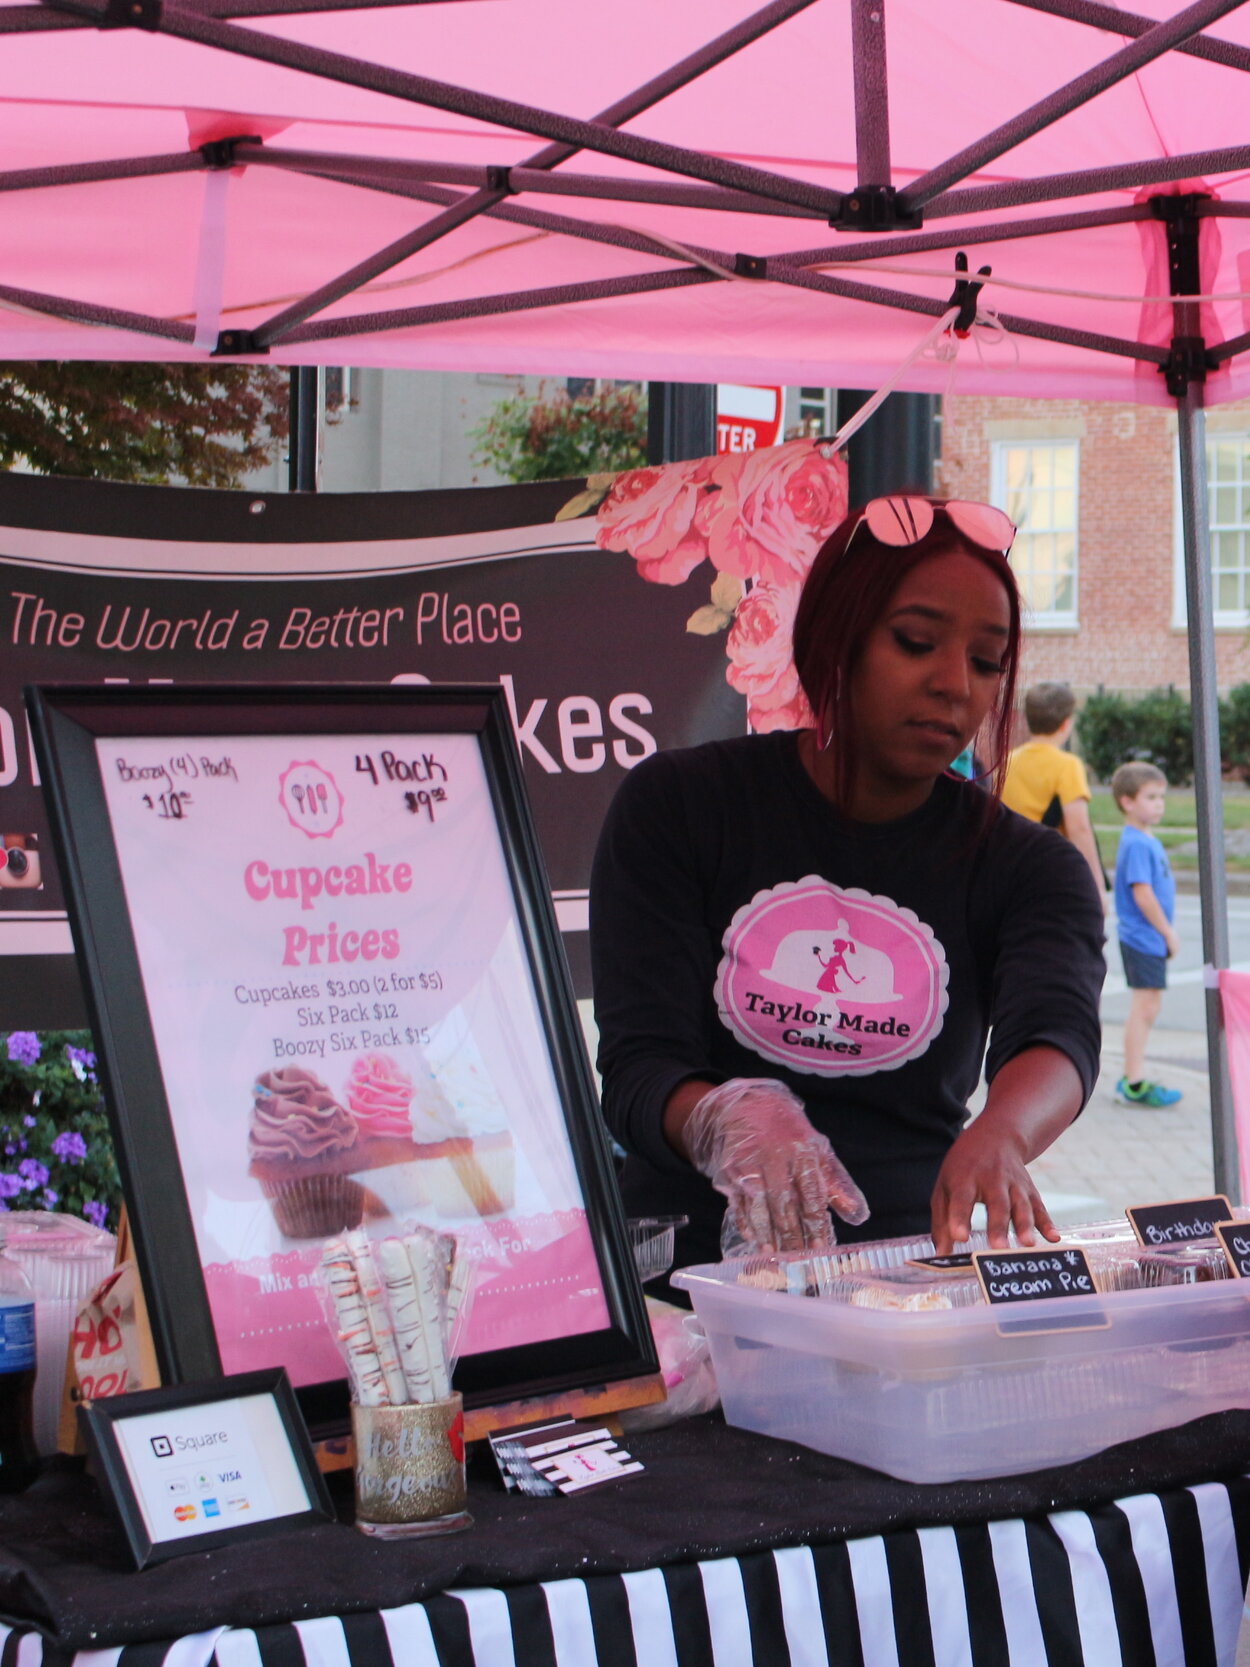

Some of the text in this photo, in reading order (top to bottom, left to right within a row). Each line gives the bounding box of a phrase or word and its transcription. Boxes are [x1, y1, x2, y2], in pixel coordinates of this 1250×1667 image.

[718, 423, 756, 453] TER
[11, 592, 522, 651] The World a Better Place
[170, 753, 199, 778] (4)
[200, 756, 239, 782] Pack
[355, 750, 448, 786] 4 Pack
[244, 852, 413, 911] Cupcake
[282, 921, 400, 966] Prices
[234, 971, 443, 1006] Cupcakes $3.00 (2 for $5)
[297, 1003, 399, 1028] Six Pack $12
[745, 991, 911, 1038] Taylor Made
[273, 1027, 430, 1058] Boozy Six Pack $15
[782, 1028, 863, 1056] Cakes
[1145, 1217, 1219, 1244] Birthda
[259, 1271, 293, 1296] Mix
[1058, 1271, 1092, 1292] Pie
[174, 1431, 229, 1452] Square
[218, 1470, 242, 1484] VISA
